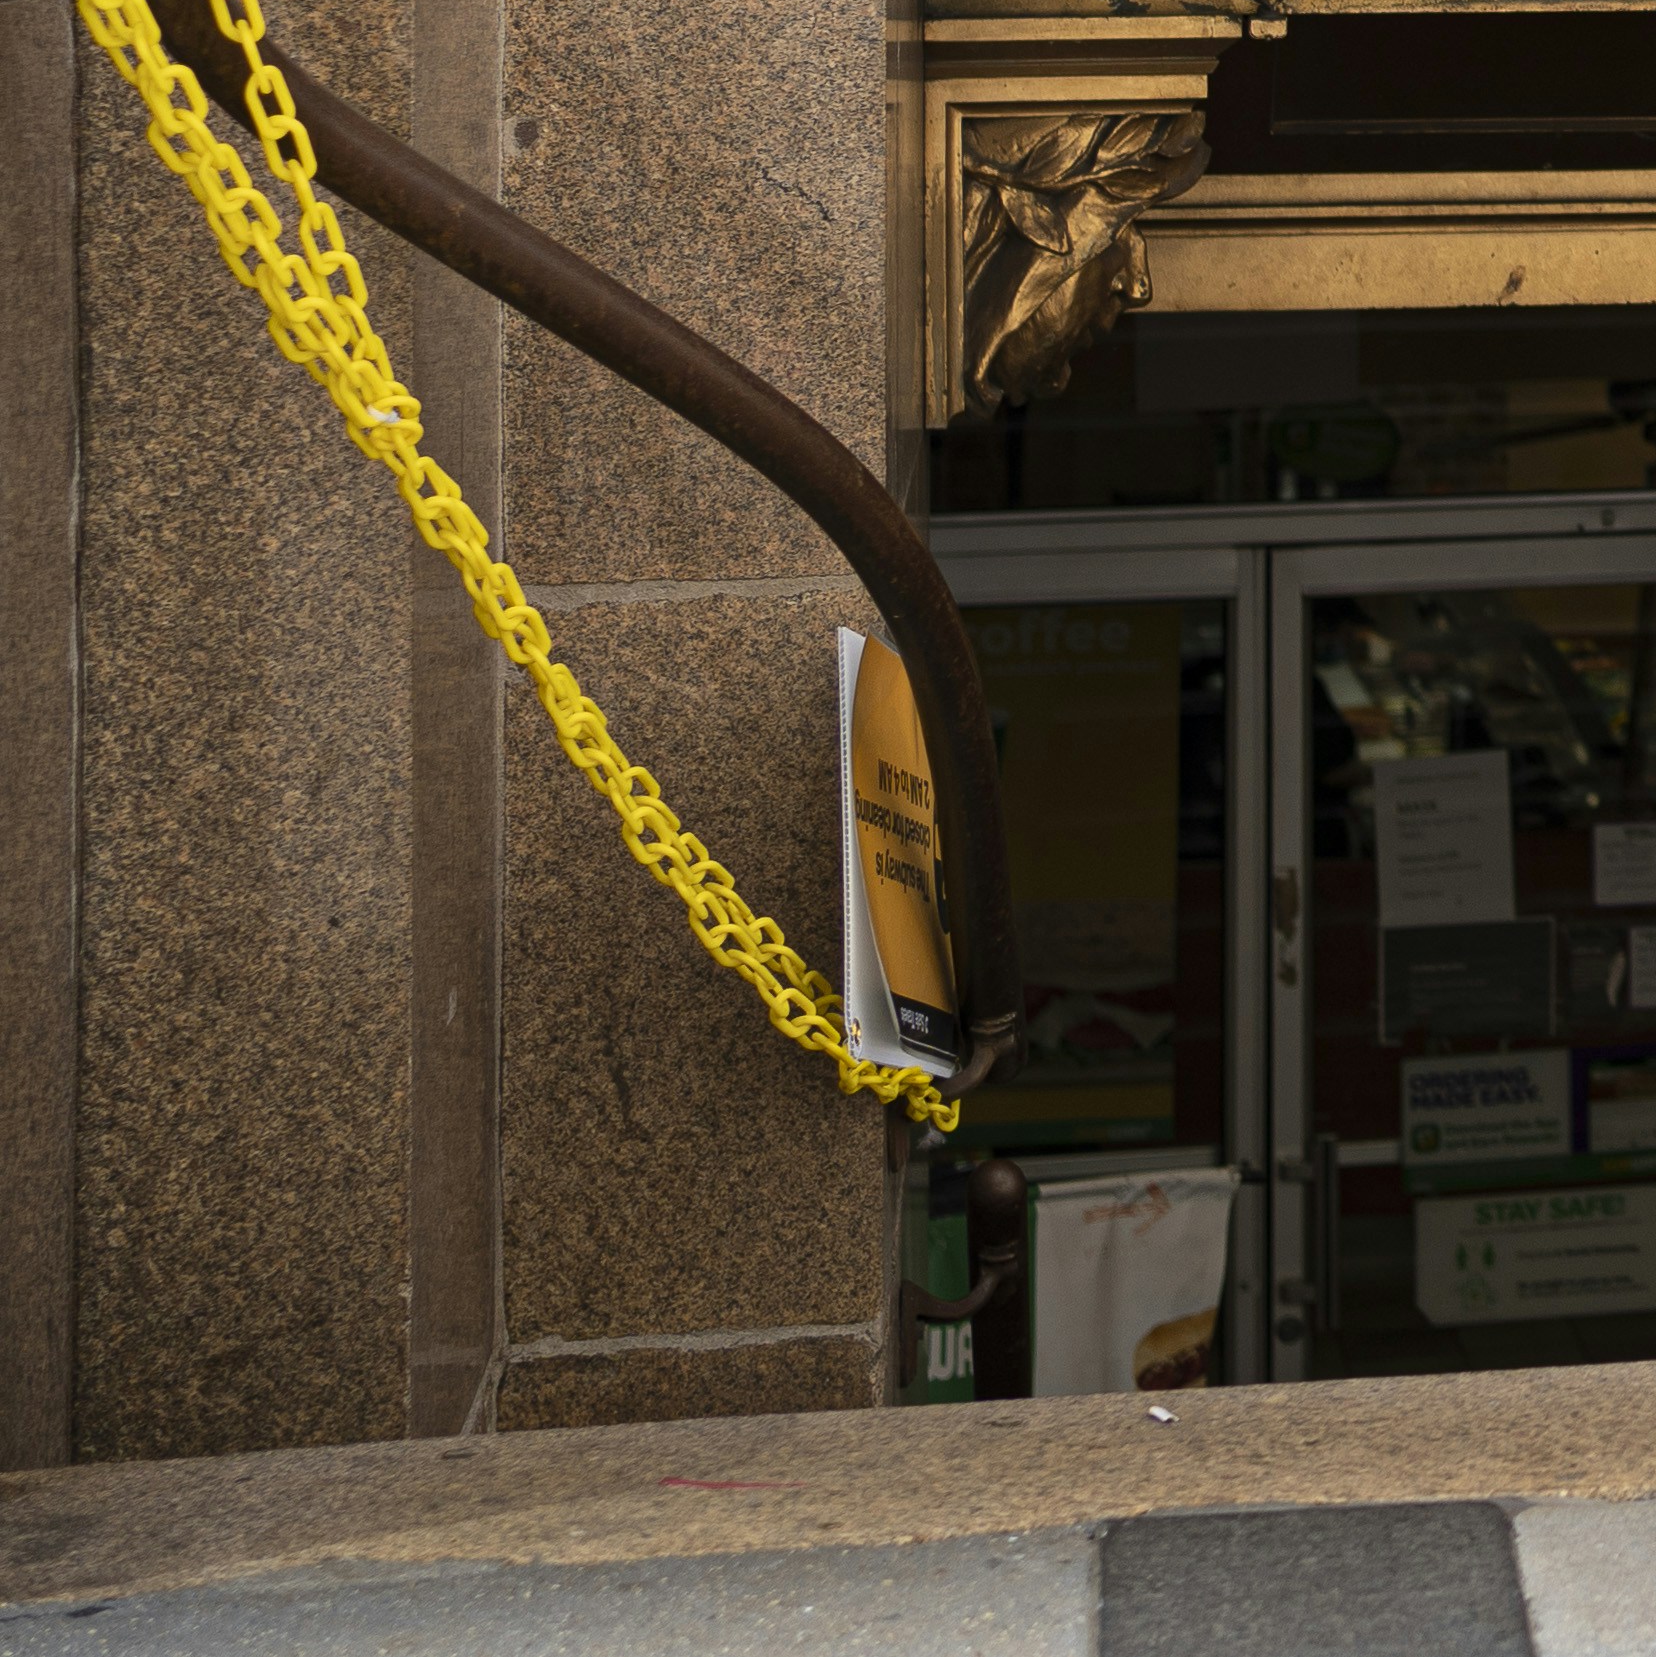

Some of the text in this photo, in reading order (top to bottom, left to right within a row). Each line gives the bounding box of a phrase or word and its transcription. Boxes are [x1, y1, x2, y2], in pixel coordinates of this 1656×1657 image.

[878, 758, 893, 794] AM
[893, 765, 900, 796] 4
[909, 773, 923, 808] AM
[923, 780, 931, 811] 2
[854, 788, 891, 839] cleaning
[885, 849, 916, 893] subway
[1475, 1200, 1541, 1226] STAY
